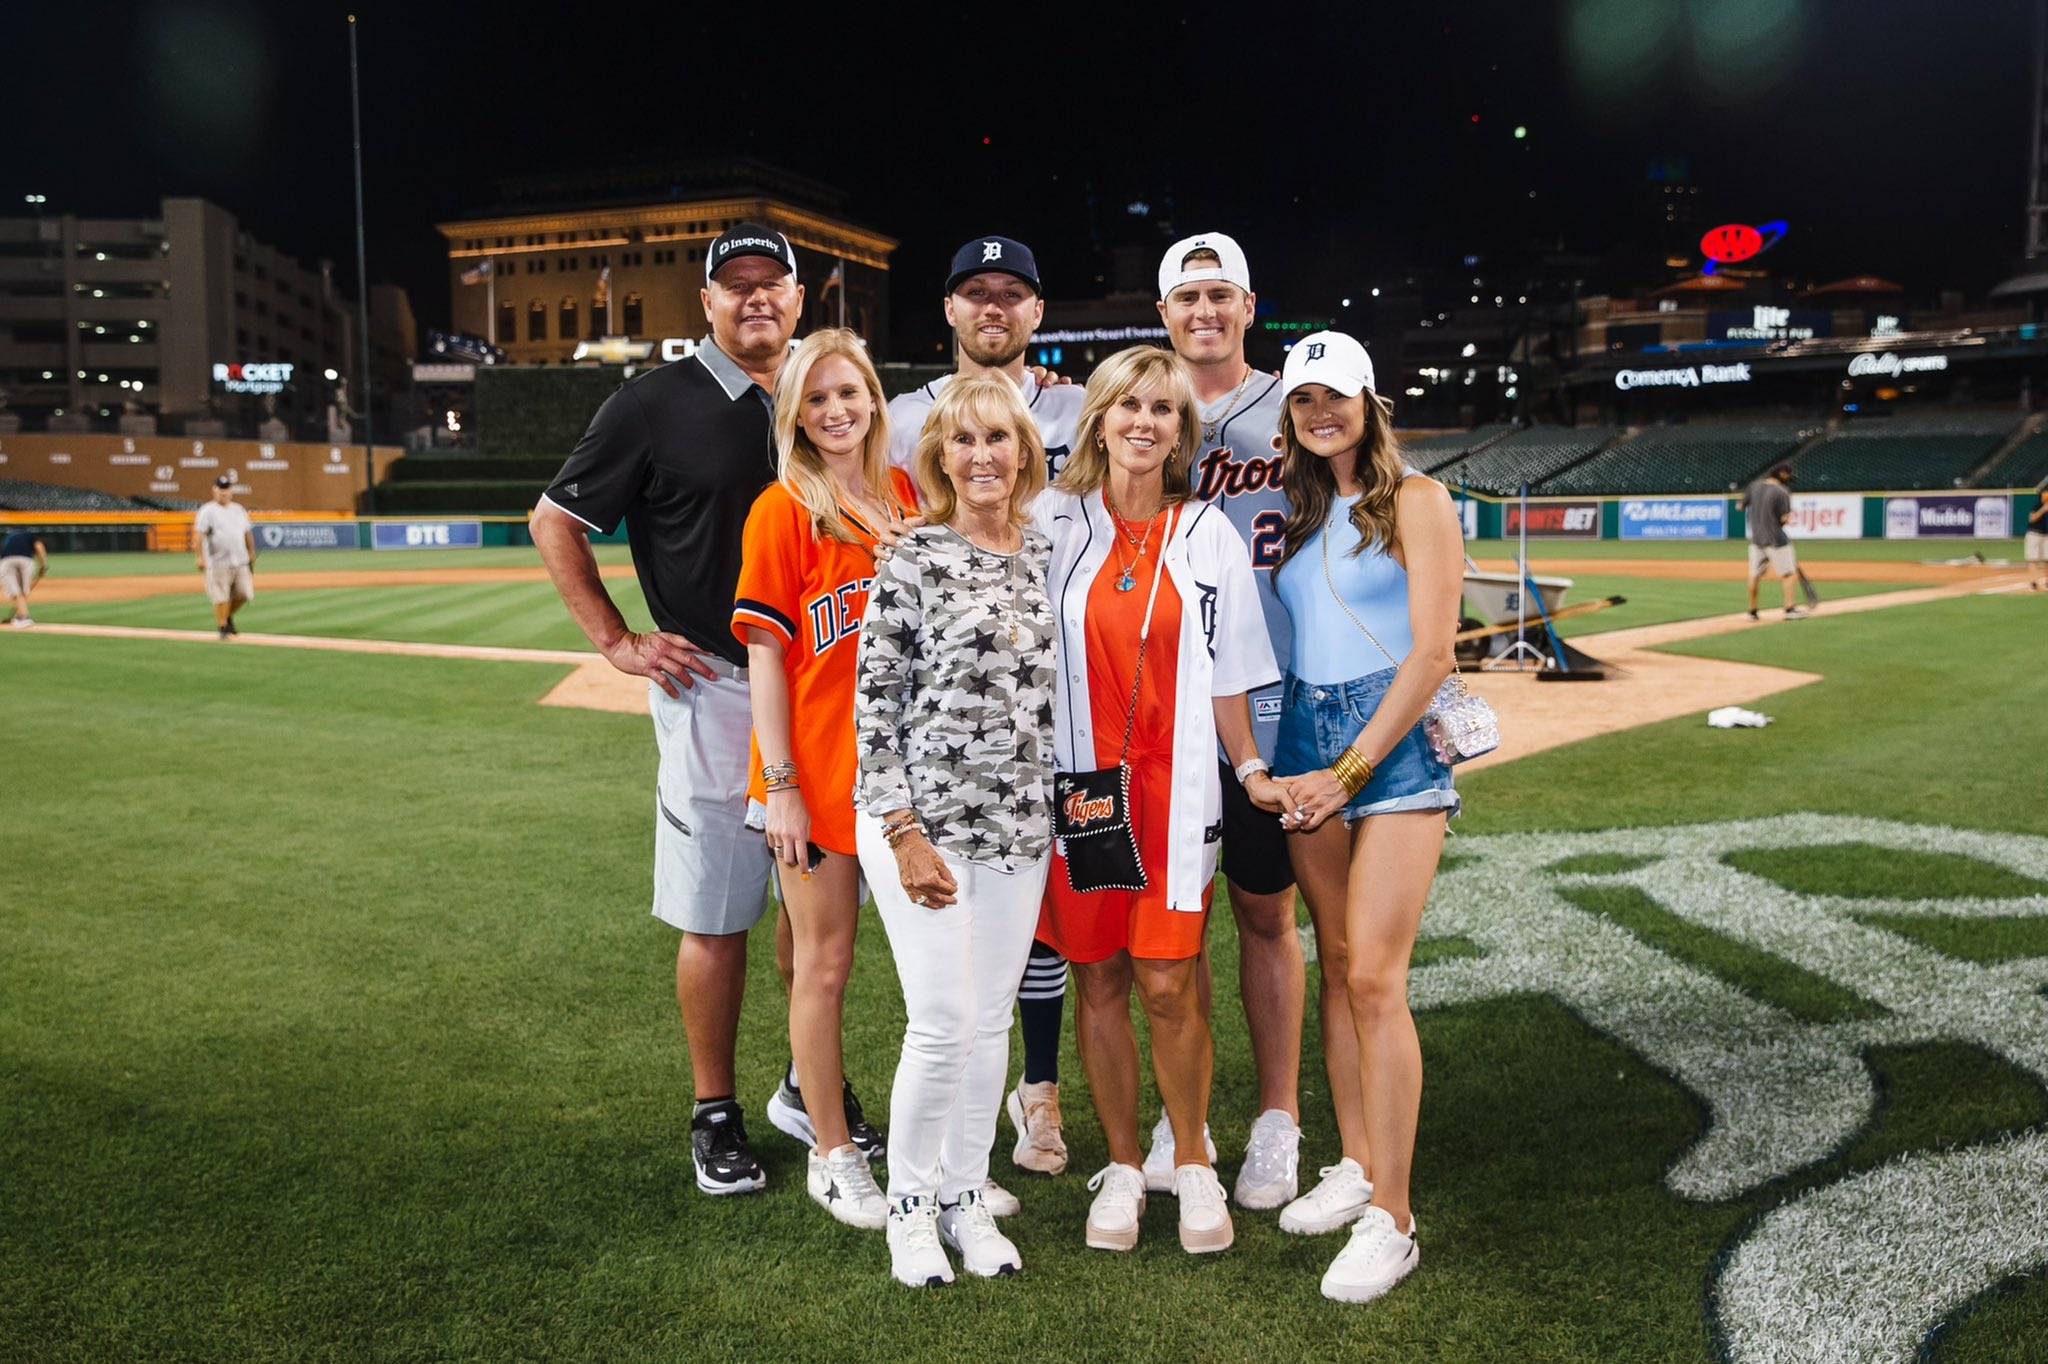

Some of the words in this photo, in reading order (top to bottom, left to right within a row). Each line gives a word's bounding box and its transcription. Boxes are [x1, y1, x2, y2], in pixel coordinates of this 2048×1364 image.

[730, 236, 780, 253] Insperity
[982, 241, 1002, 264] D
[1304, 342, 1326, 366] D
[1701, 362, 1752, 384] Bank
[1196, 434, 1284, 503] troi
[1650, 503, 1721, 521] McLaren
[1788, 500, 1846, 533] eijer
[406, 524, 450, 546] DTE
[1063, 788, 1114, 827] Tigers
